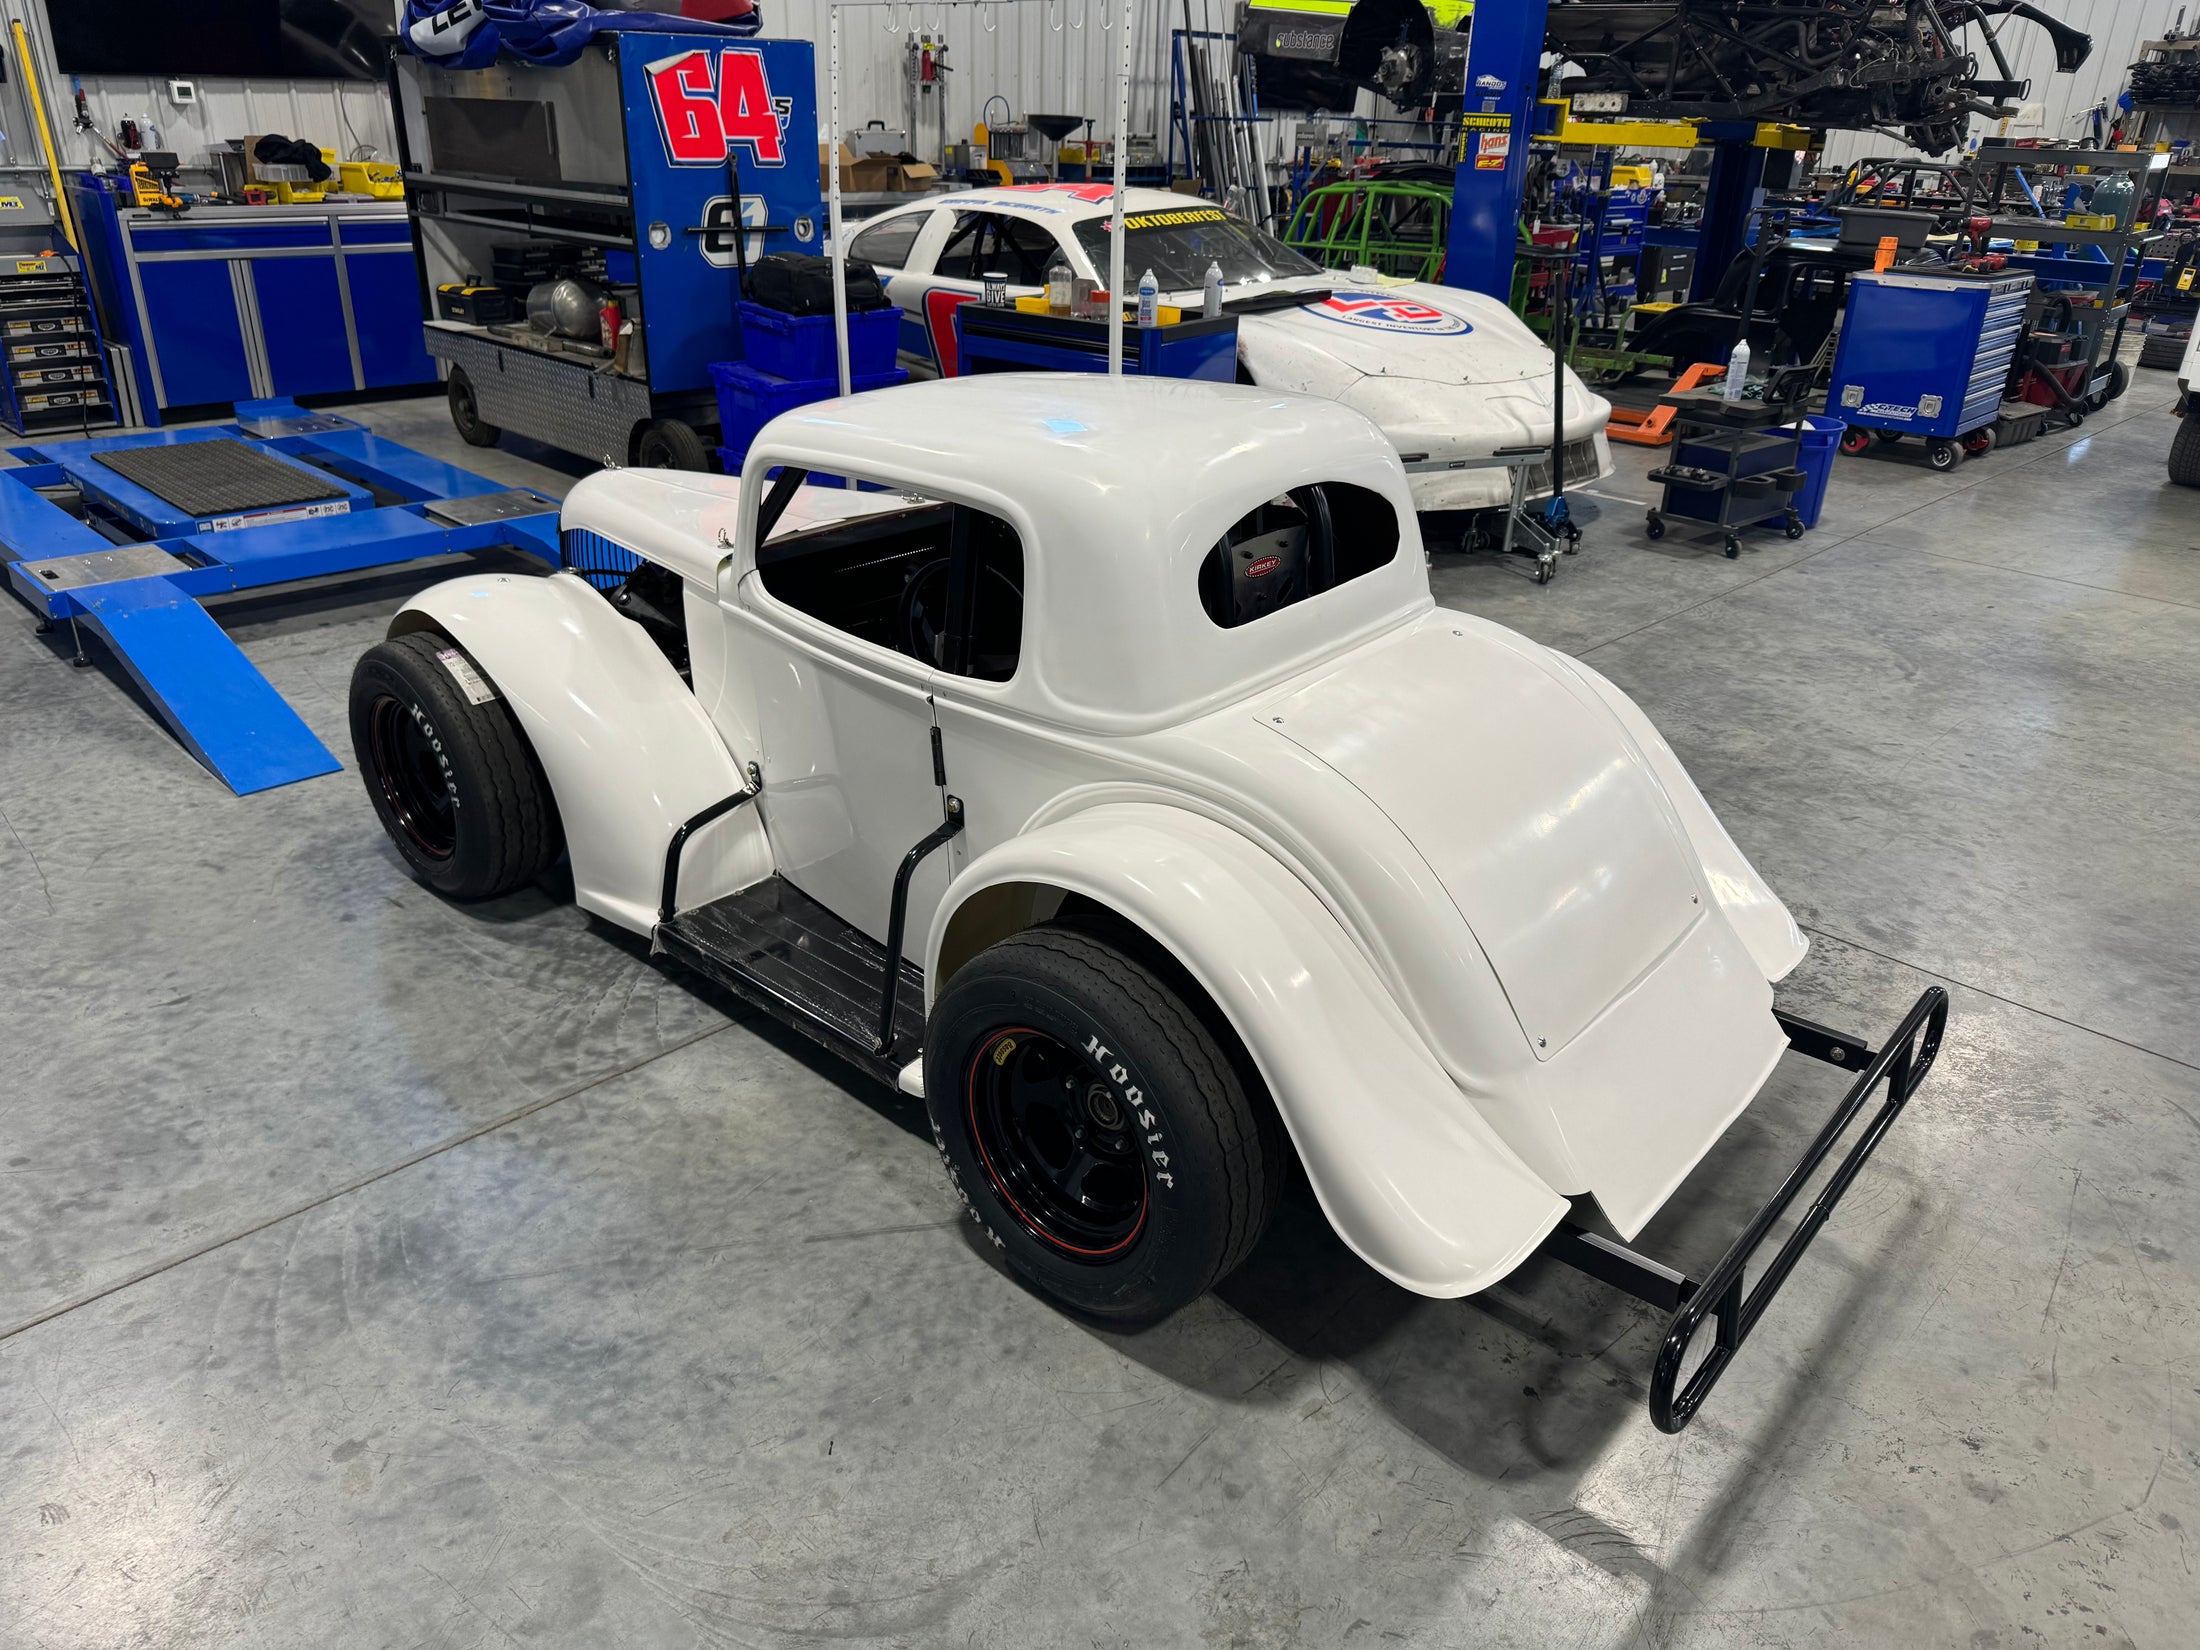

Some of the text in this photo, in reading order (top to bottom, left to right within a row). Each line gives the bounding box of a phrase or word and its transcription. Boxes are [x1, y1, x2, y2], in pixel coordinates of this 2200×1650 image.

[1276, 30, 1335, 49] substance
[643, 47, 787, 168] 64
[1463, 117, 1511, 127] SCHROTH
[1481, 134, 1508, 153] hans
[1124, 209, 1226, 229] OKTOBERFEST
[1250, 560, 1277, 572] KIRKEY
[1081, 1034, 1174, 1189] Hoosier
